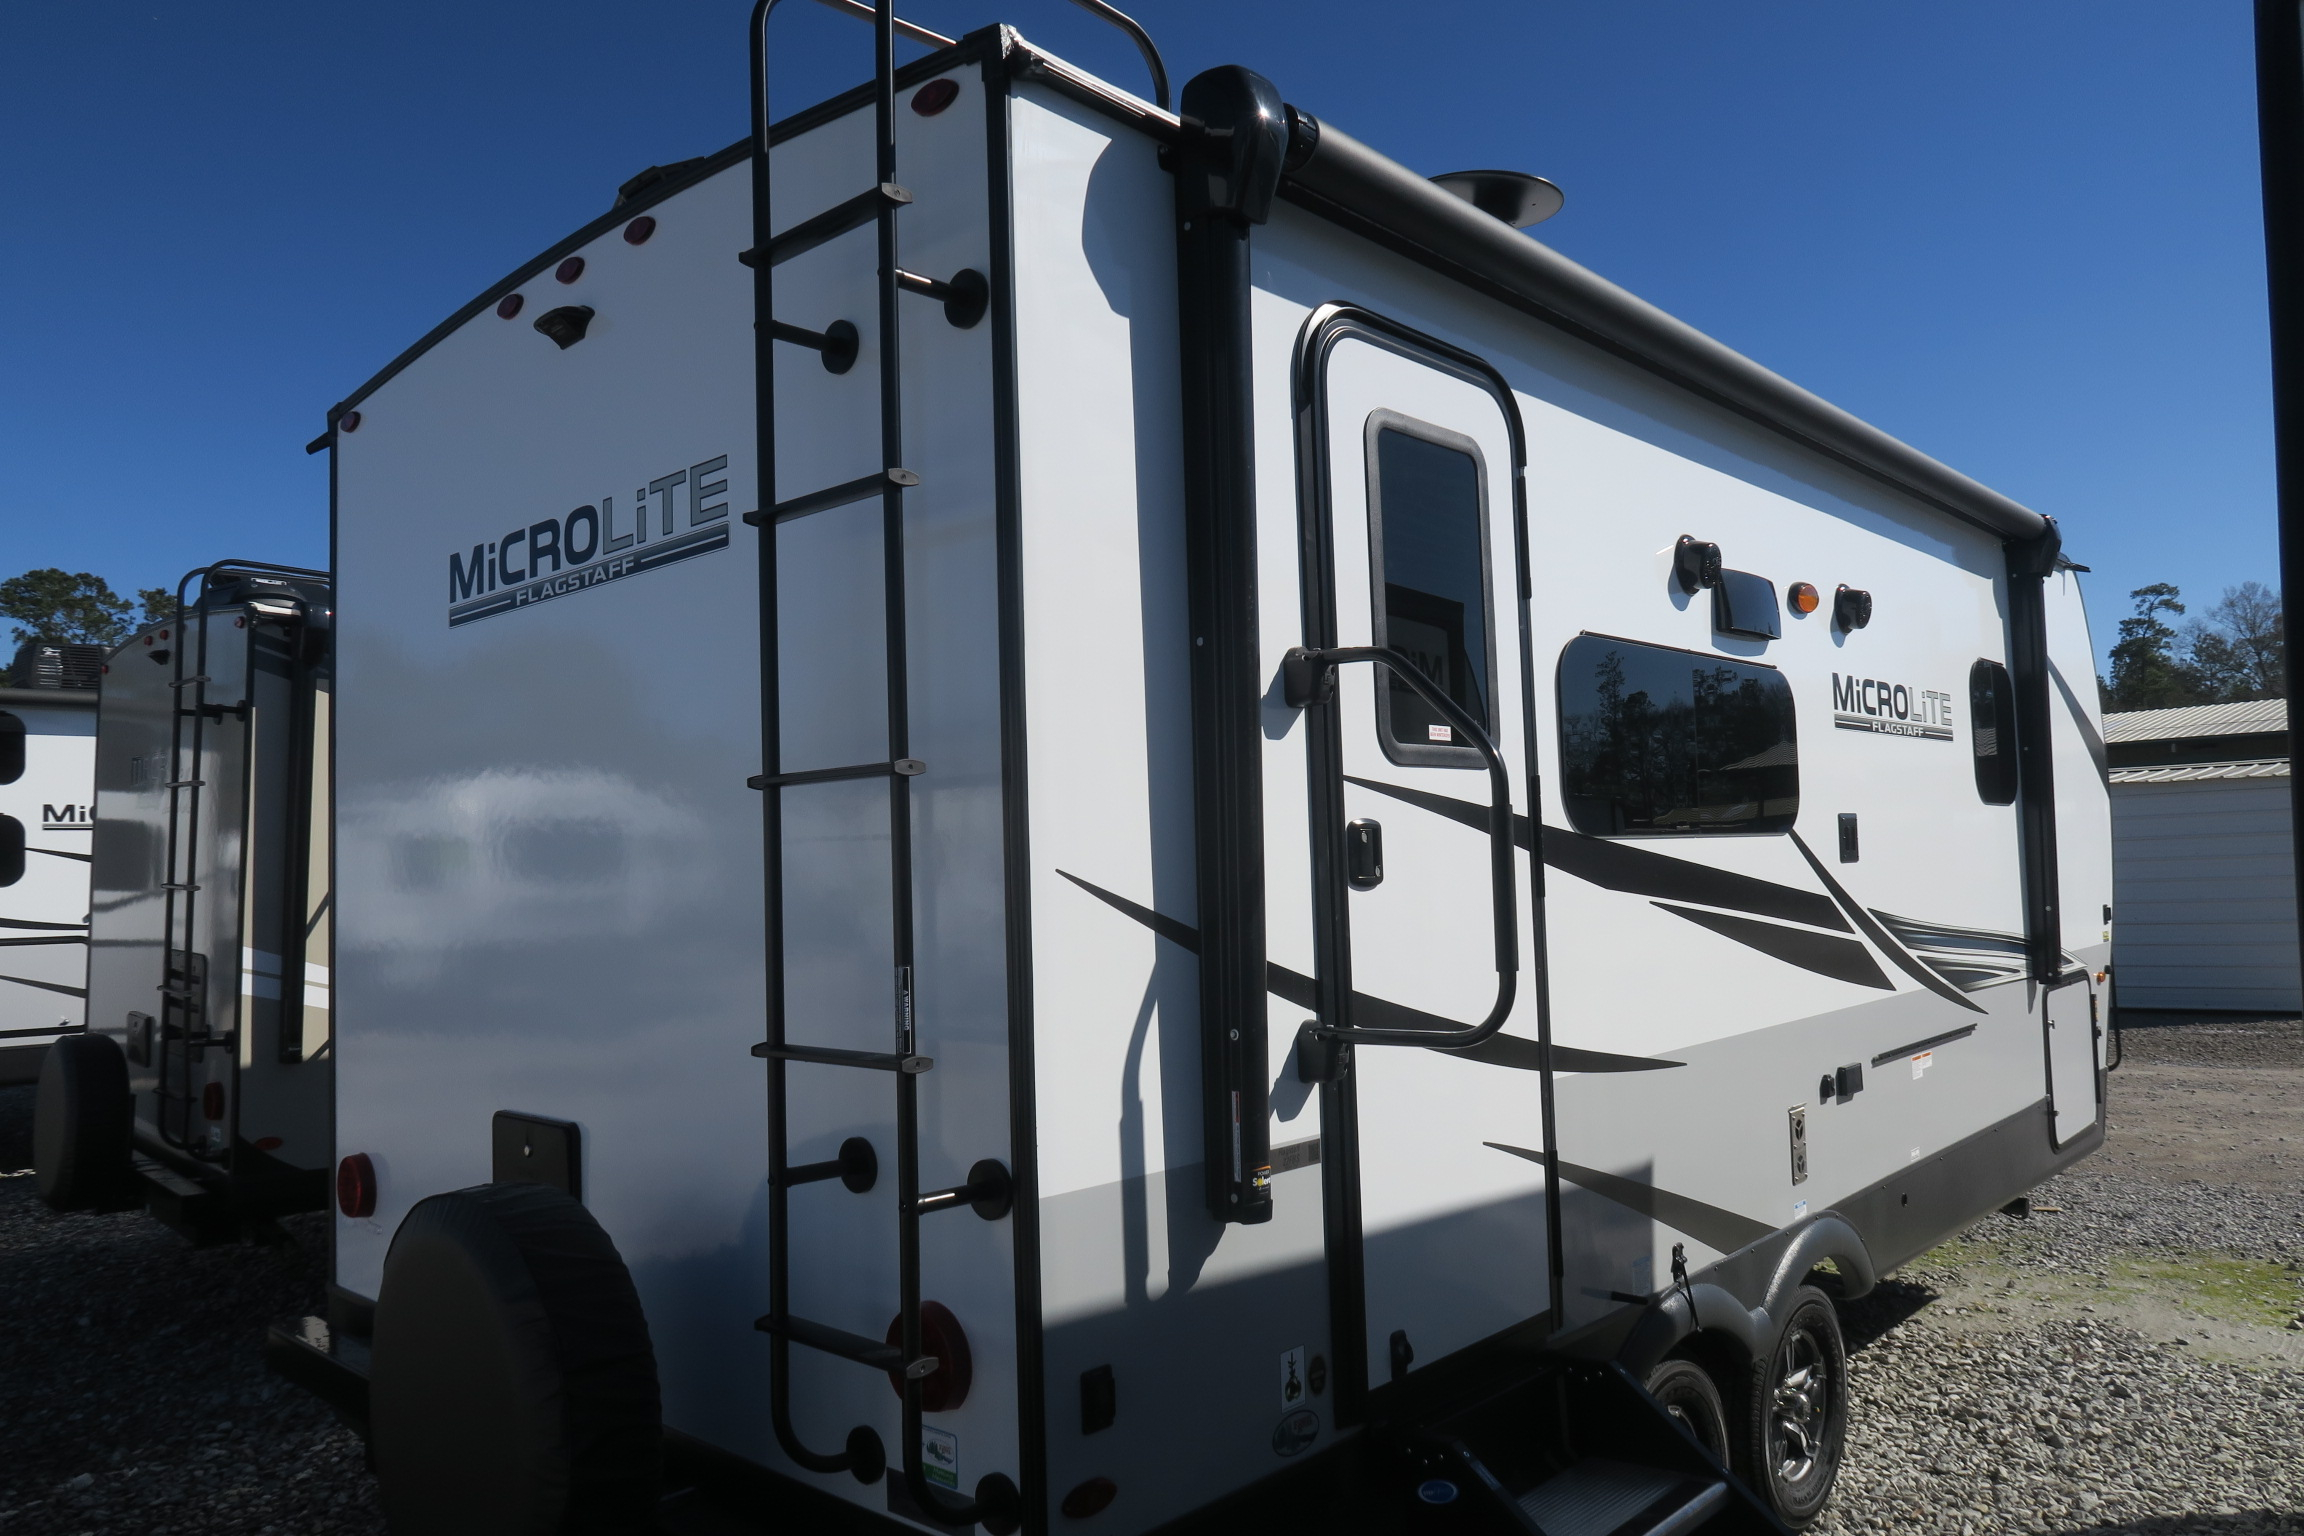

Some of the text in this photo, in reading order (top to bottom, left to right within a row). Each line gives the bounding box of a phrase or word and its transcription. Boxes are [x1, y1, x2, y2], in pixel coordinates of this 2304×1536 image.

[450, 454, 728, 604] MiCROLiTE
[515, 554, 636, 606] FLAGSTAFF
[1832, 672, 1952, 727] MiCROLiTE
[1872, 721, 1924, 737] FLAGSTAFF
[43, 804, 95, 822] Mi
